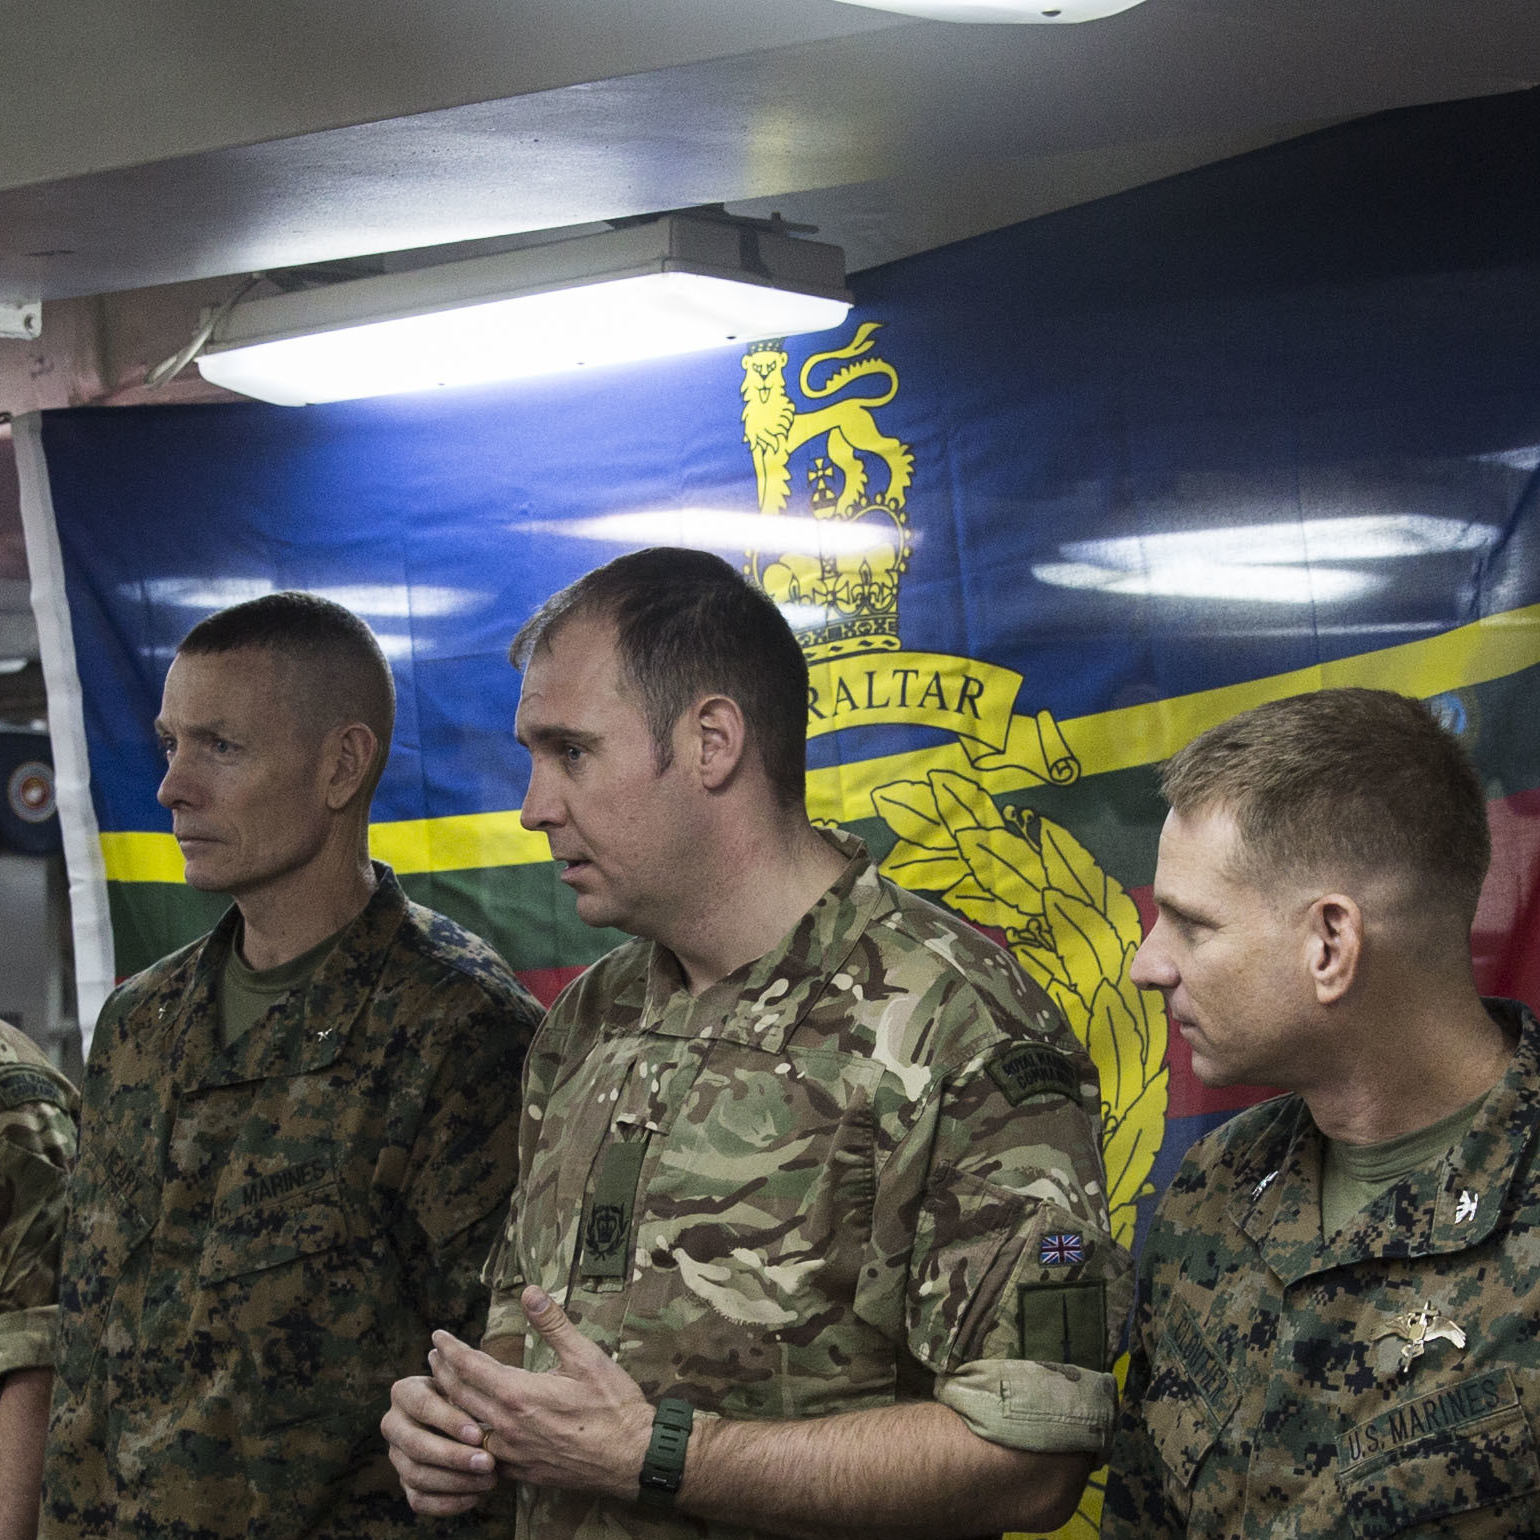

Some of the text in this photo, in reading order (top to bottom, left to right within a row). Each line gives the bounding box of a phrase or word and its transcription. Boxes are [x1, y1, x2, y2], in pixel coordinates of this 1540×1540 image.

[242, 1160, 325, 1206] MARINES
[1348, 1379, 1500, 1461] U.S. MARINES
